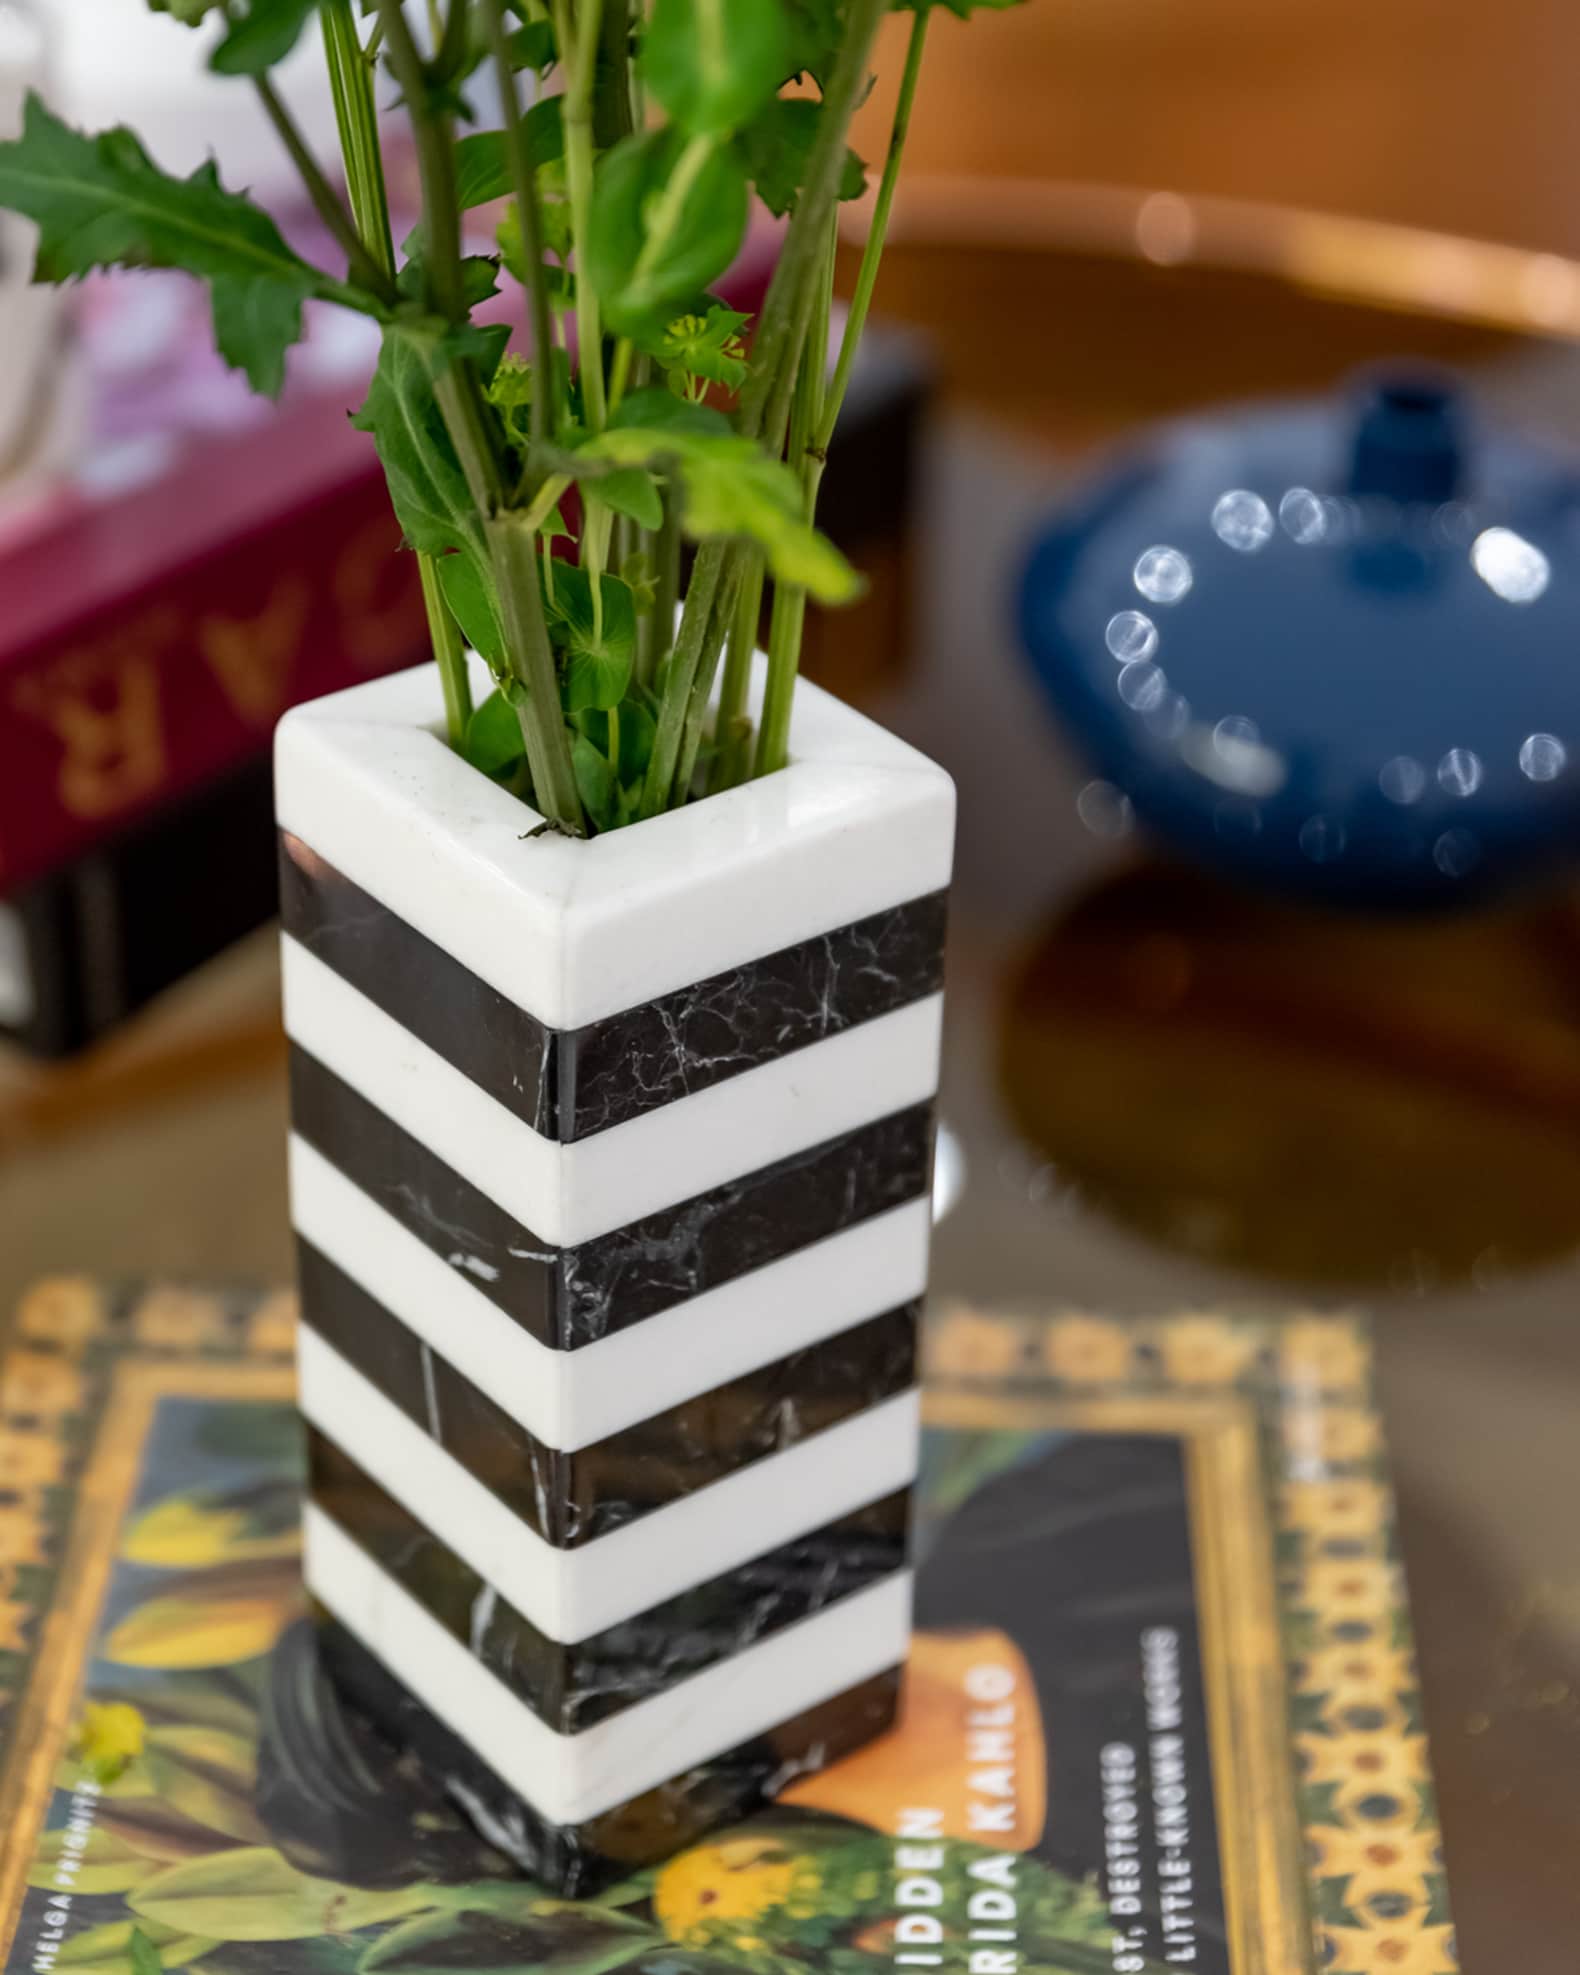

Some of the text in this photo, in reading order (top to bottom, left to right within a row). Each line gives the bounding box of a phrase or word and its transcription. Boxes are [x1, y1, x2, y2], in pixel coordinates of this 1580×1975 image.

[966, 1664, 1016, 1832] KAHLO
[1100, 1742, 1143, 1915] DESTROYED
[32, 1894, 73, 1970] HELGA
[895, 1807, 945, 1975] IDDEN
[1150, 1734, 1197, 1963] LITTLE-KNOWN
